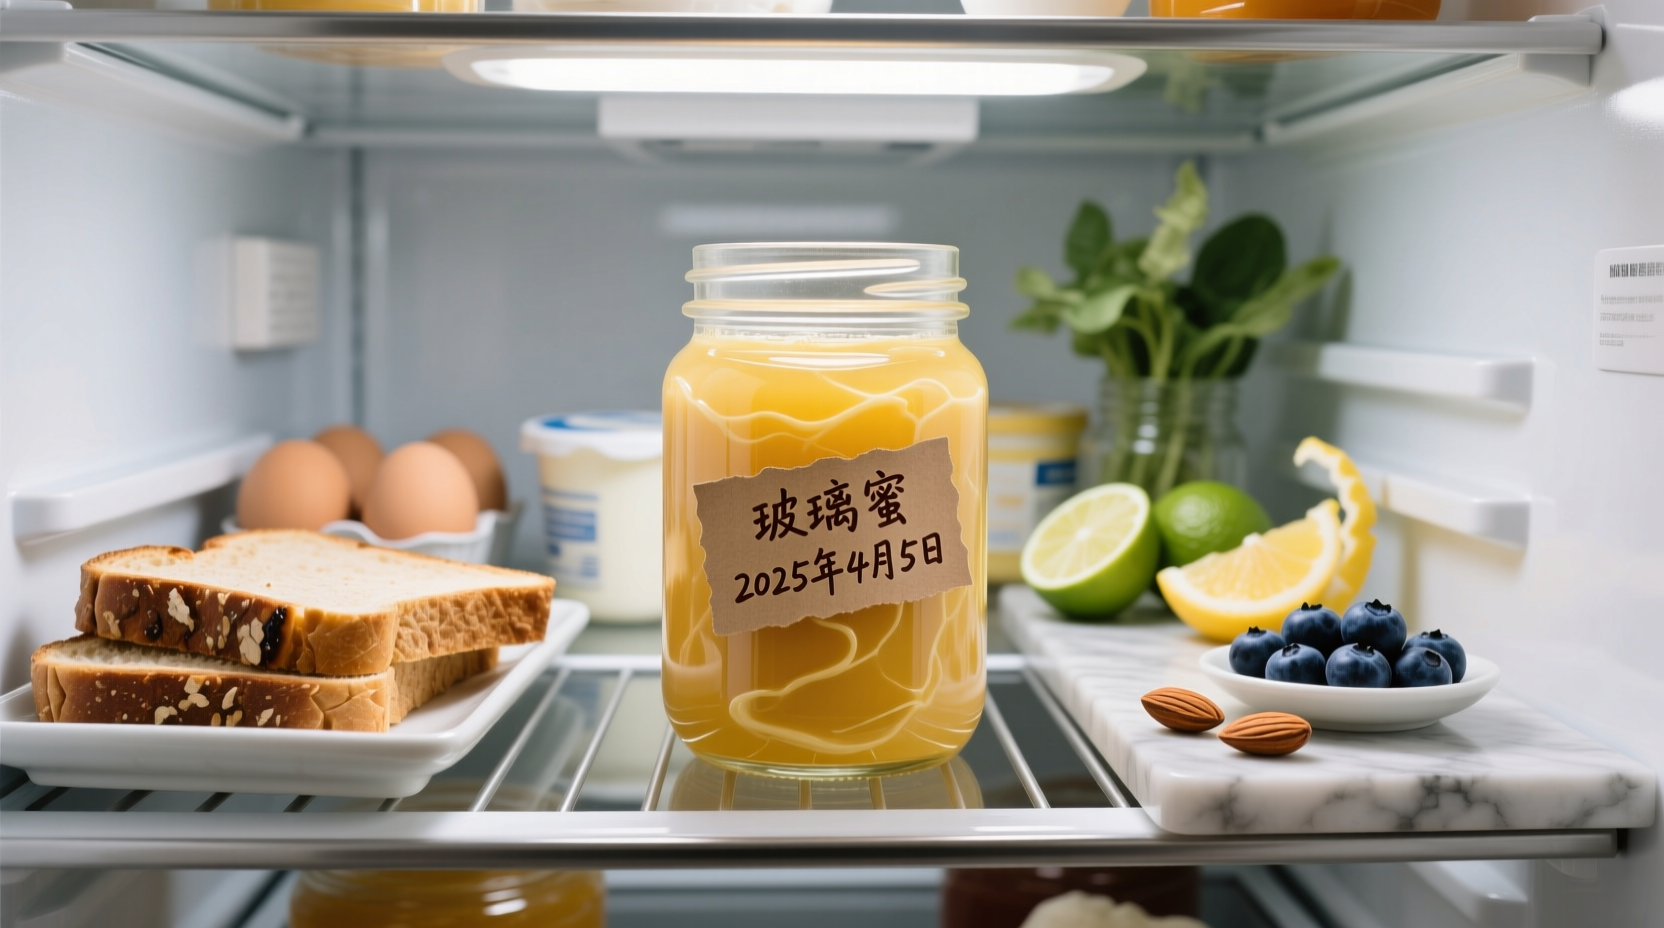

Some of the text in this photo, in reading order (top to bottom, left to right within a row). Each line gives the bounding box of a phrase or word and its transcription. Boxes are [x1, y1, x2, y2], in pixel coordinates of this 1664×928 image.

[752, 470, 907, 541] 玻璃蜜
[734, 532, 943, 604] 2025年4月5日
